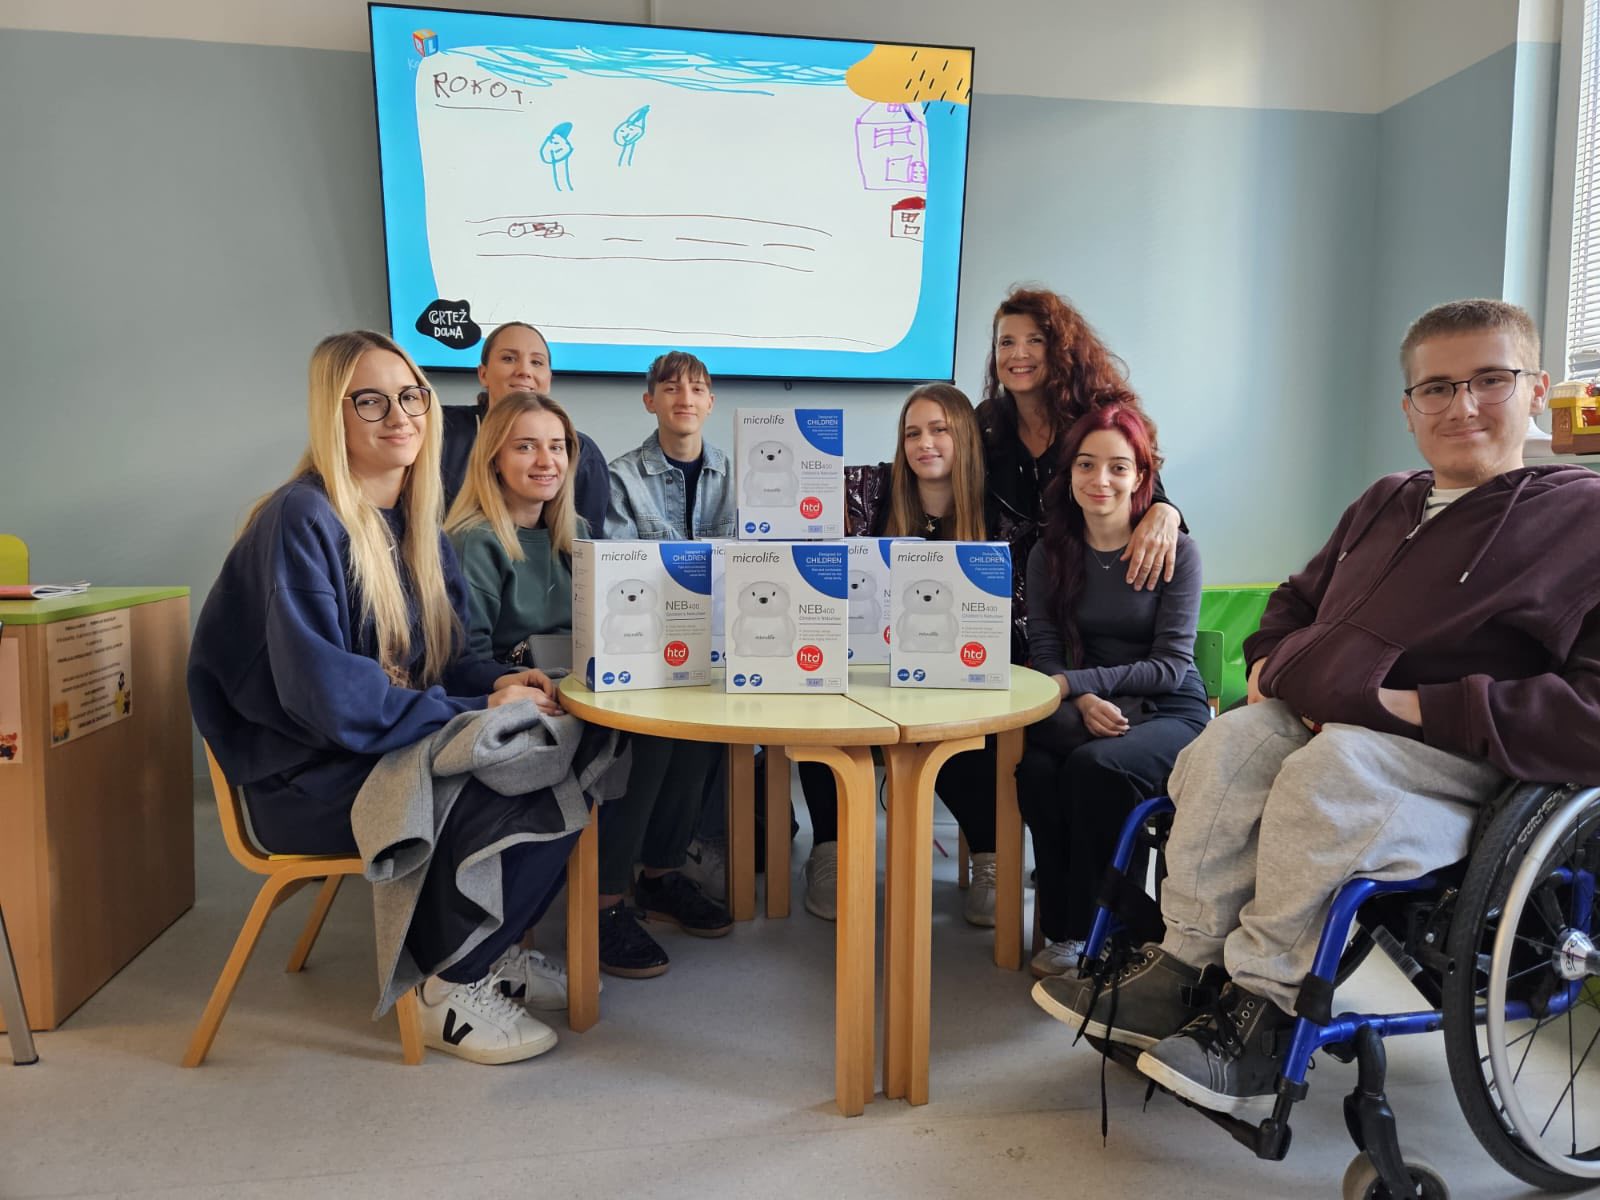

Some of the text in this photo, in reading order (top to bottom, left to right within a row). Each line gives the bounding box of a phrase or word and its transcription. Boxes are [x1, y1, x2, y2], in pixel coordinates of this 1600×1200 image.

[428, 308, 468, 326] CRTEŽ
[743, 414, 785, 425] microlife
[802, 502, 820, 512] htd
[601, 550, 648, 561] microlife
[732, 551, 780, 563] microlife
[898, 551, 944, 562] microlife
[969, 556, 1005, 564] CHILDREN
[667, 647, 686, 657] htd
[800, 652, 820, 663] htd
[963, 648, 984, 659] htd
